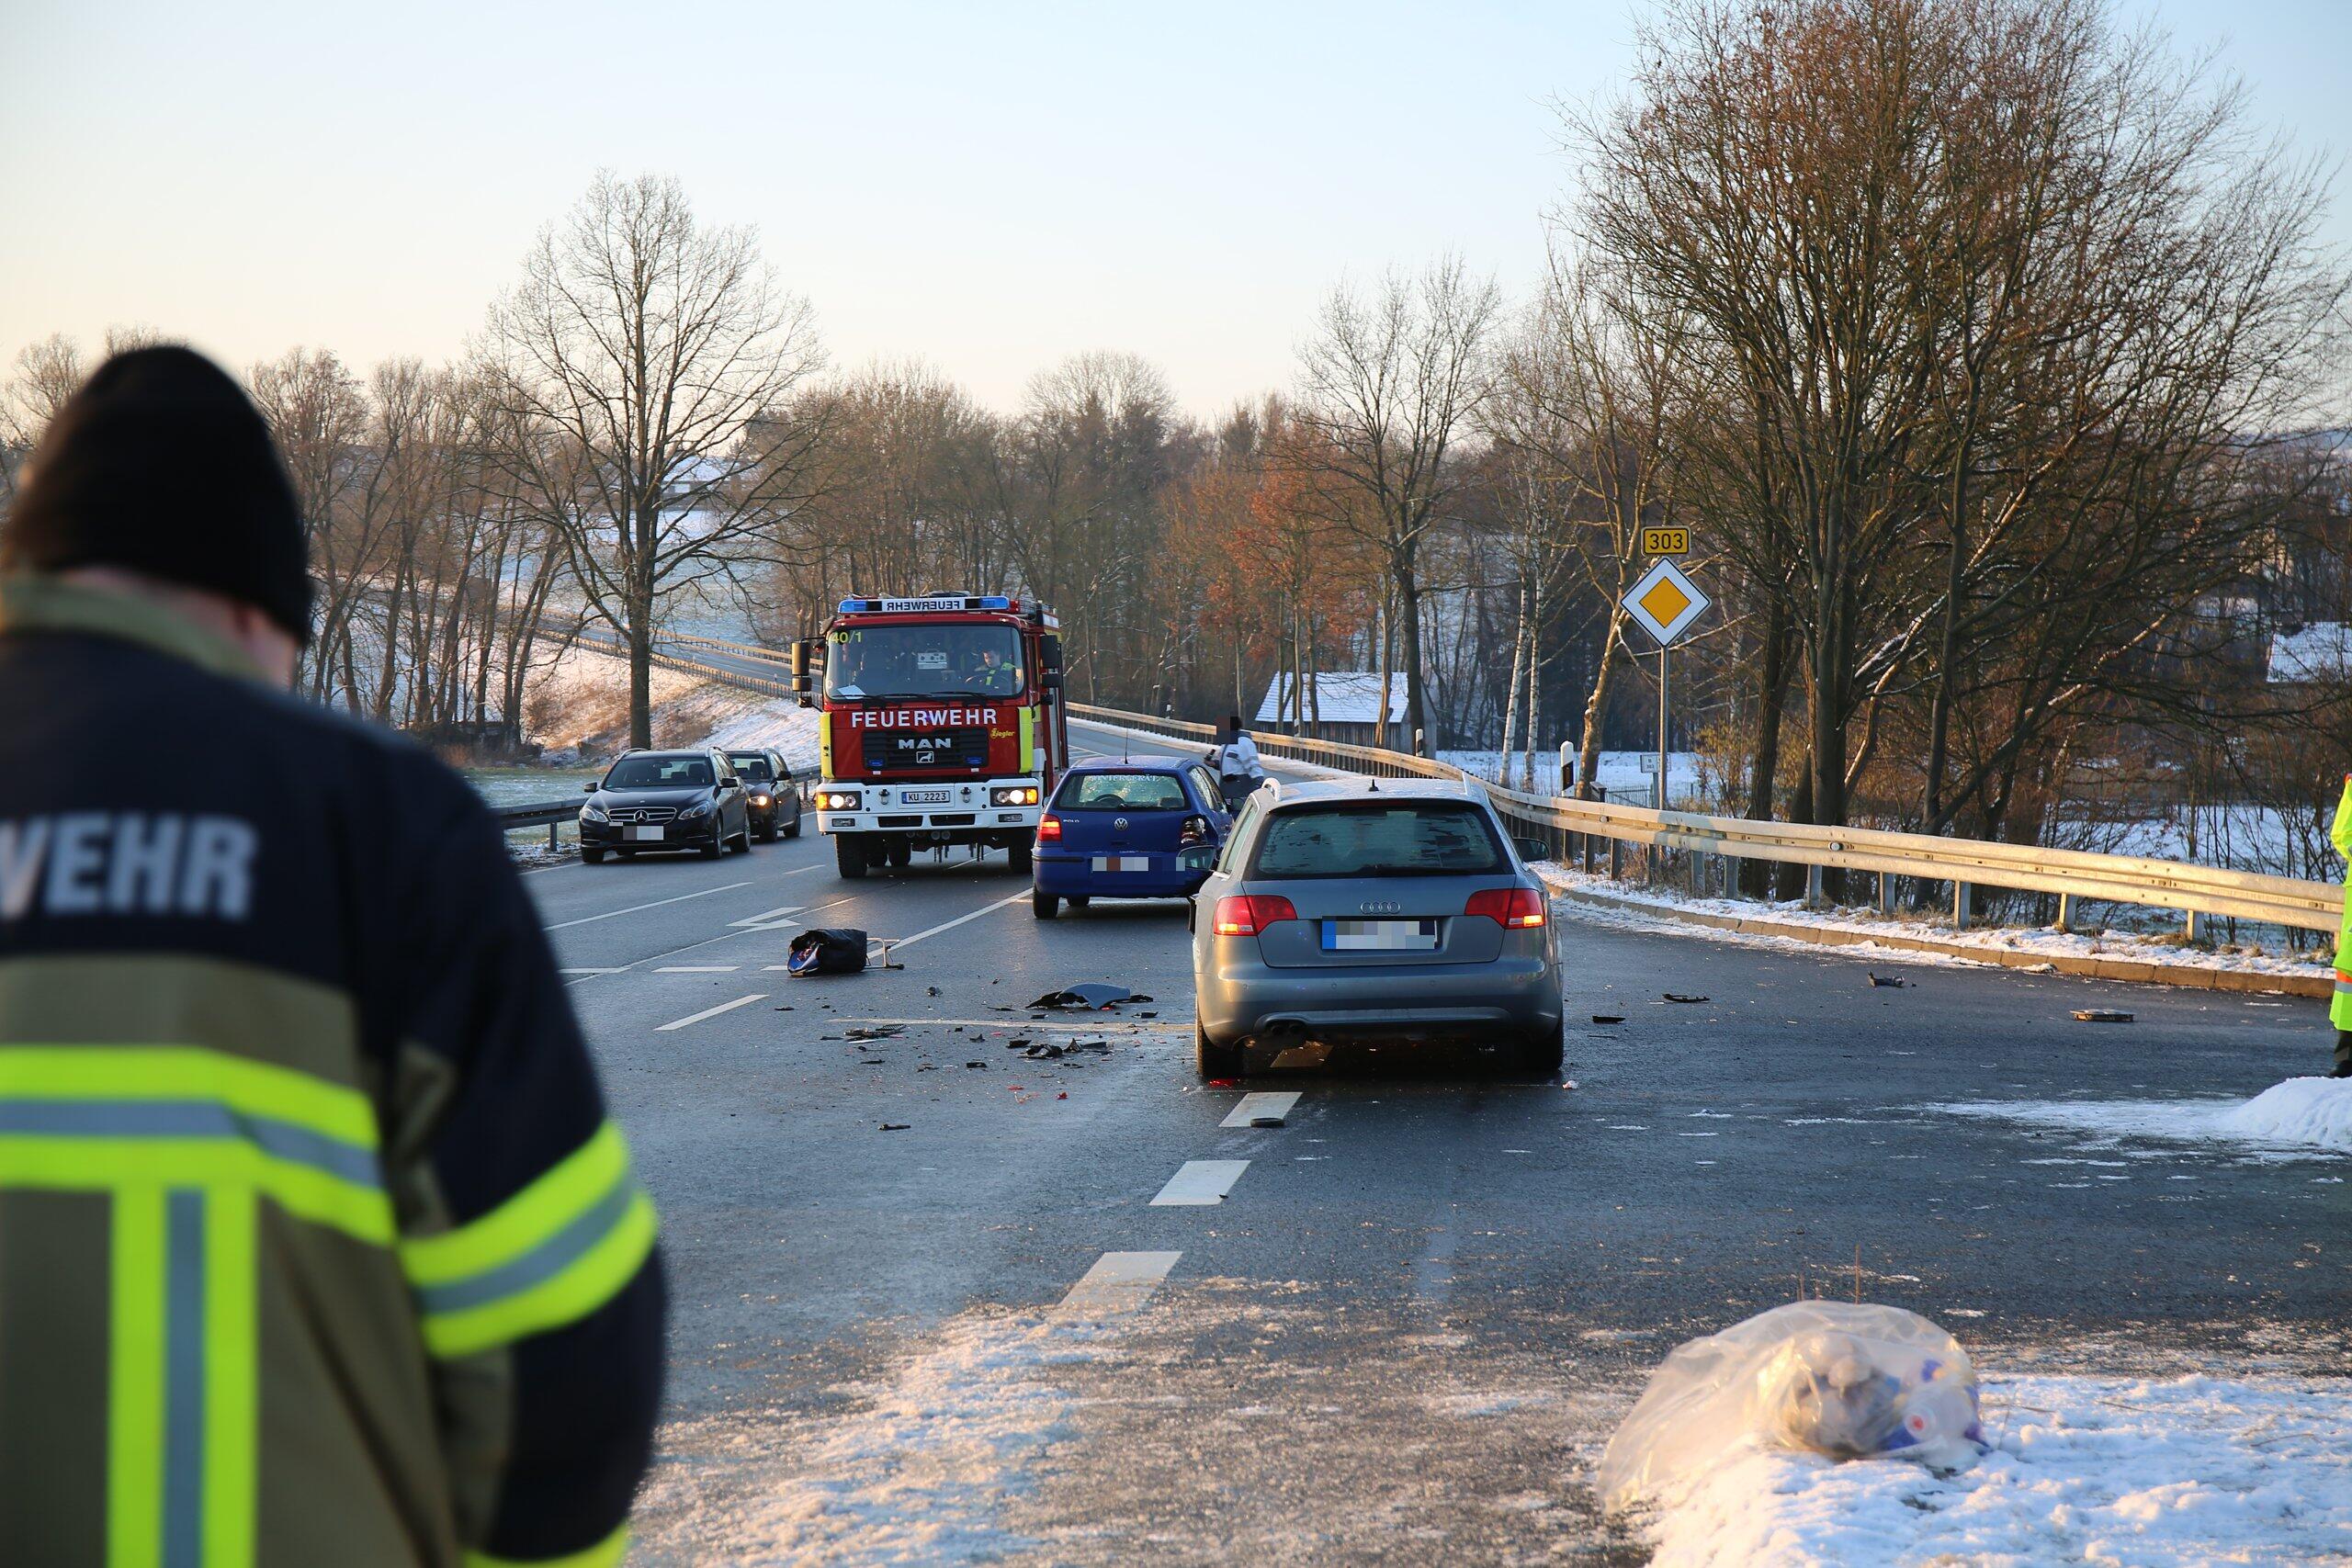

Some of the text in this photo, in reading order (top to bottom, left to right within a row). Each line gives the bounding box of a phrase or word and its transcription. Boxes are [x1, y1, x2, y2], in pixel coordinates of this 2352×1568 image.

[1649, 533, 1683, 549] 303
[831, 630, 862, 643] 40/1
[851, 708, 997, 728] FEUERWEHR
[990, 728, 1015, 739] Ziegler
[898, 738, 952, 750] MAN
[908, 793, 946, 801] KU 2223
